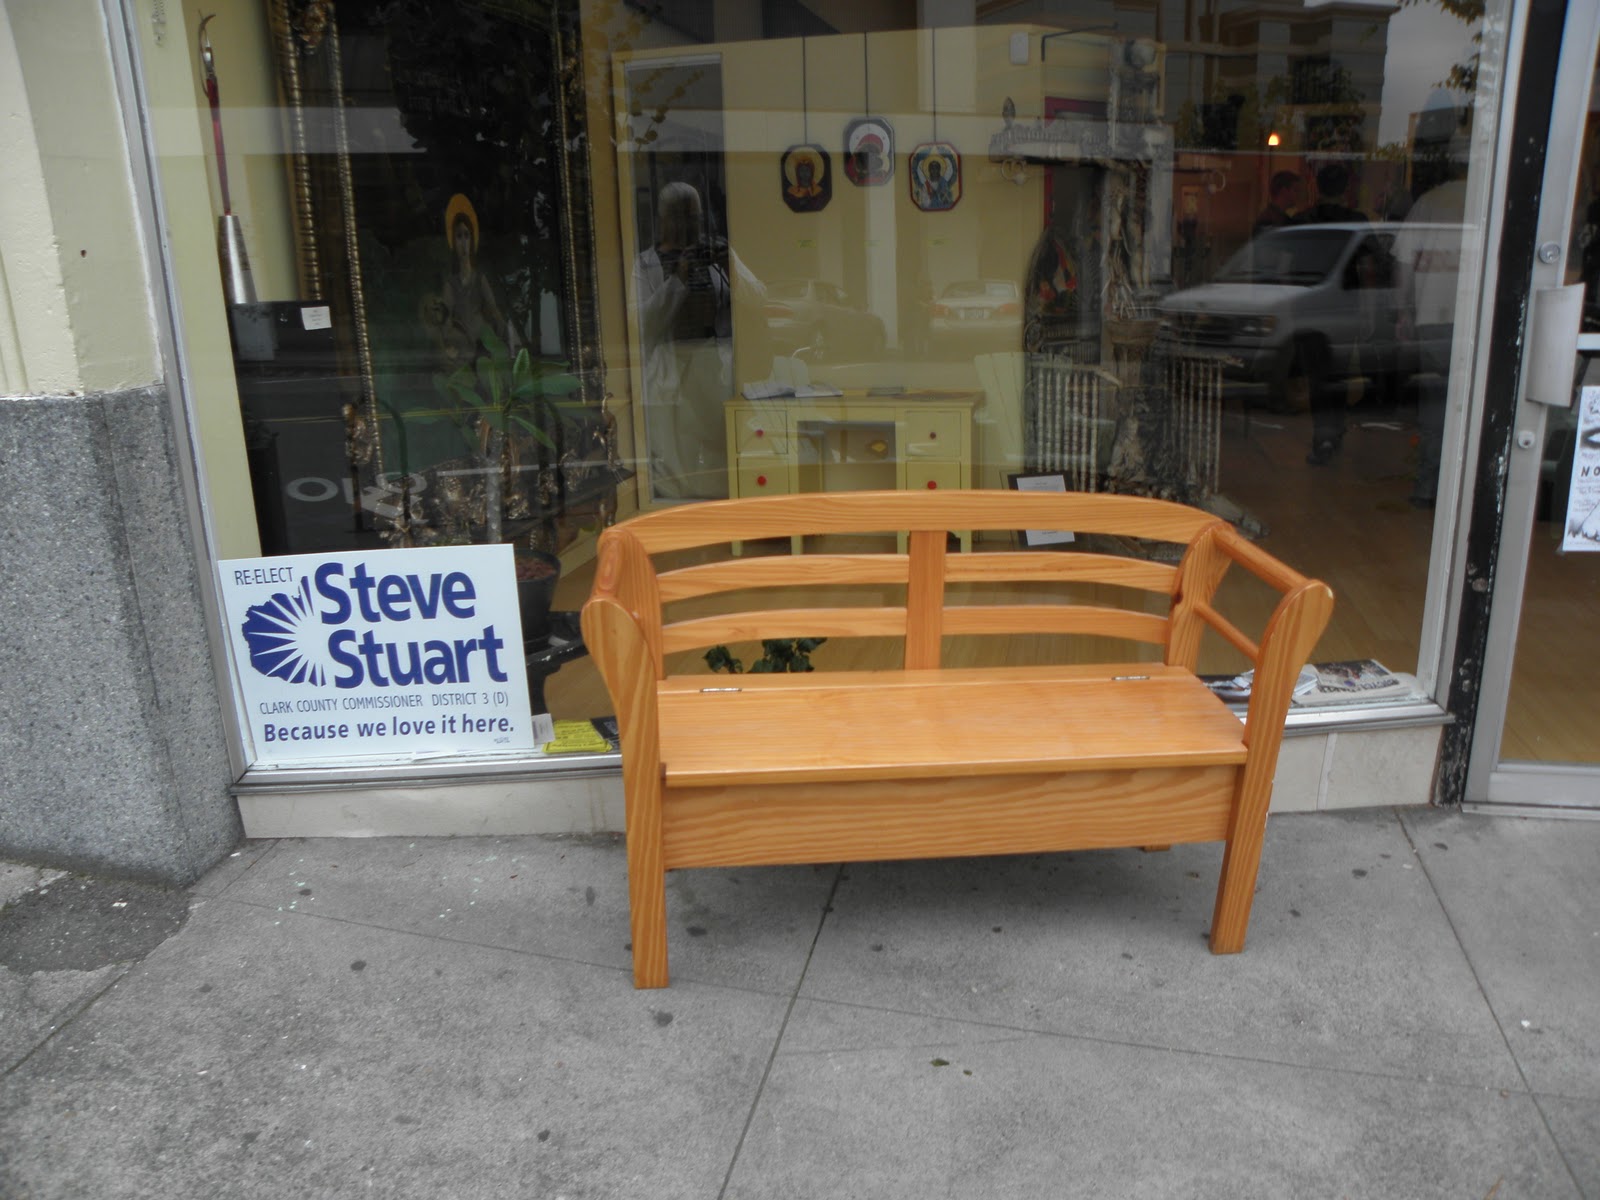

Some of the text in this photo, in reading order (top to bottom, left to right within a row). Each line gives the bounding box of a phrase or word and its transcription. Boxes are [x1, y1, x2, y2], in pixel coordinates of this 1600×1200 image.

[234, 566, 293, 586] RE-ELECT
[314, 562, 477, 625] Steve
[327, 624, 508, 689] Stuart
[259, 691, 509, 715] CLARK COUNTY COMMISSIONER DISTRICT 3 (D)
[264, 722, 350, 742] Because
[357, 722, 388, 738] we
[392, 716, 436, 736] love
[441, 714, 457, 734] it
[462, 713, 515, 734] here.
